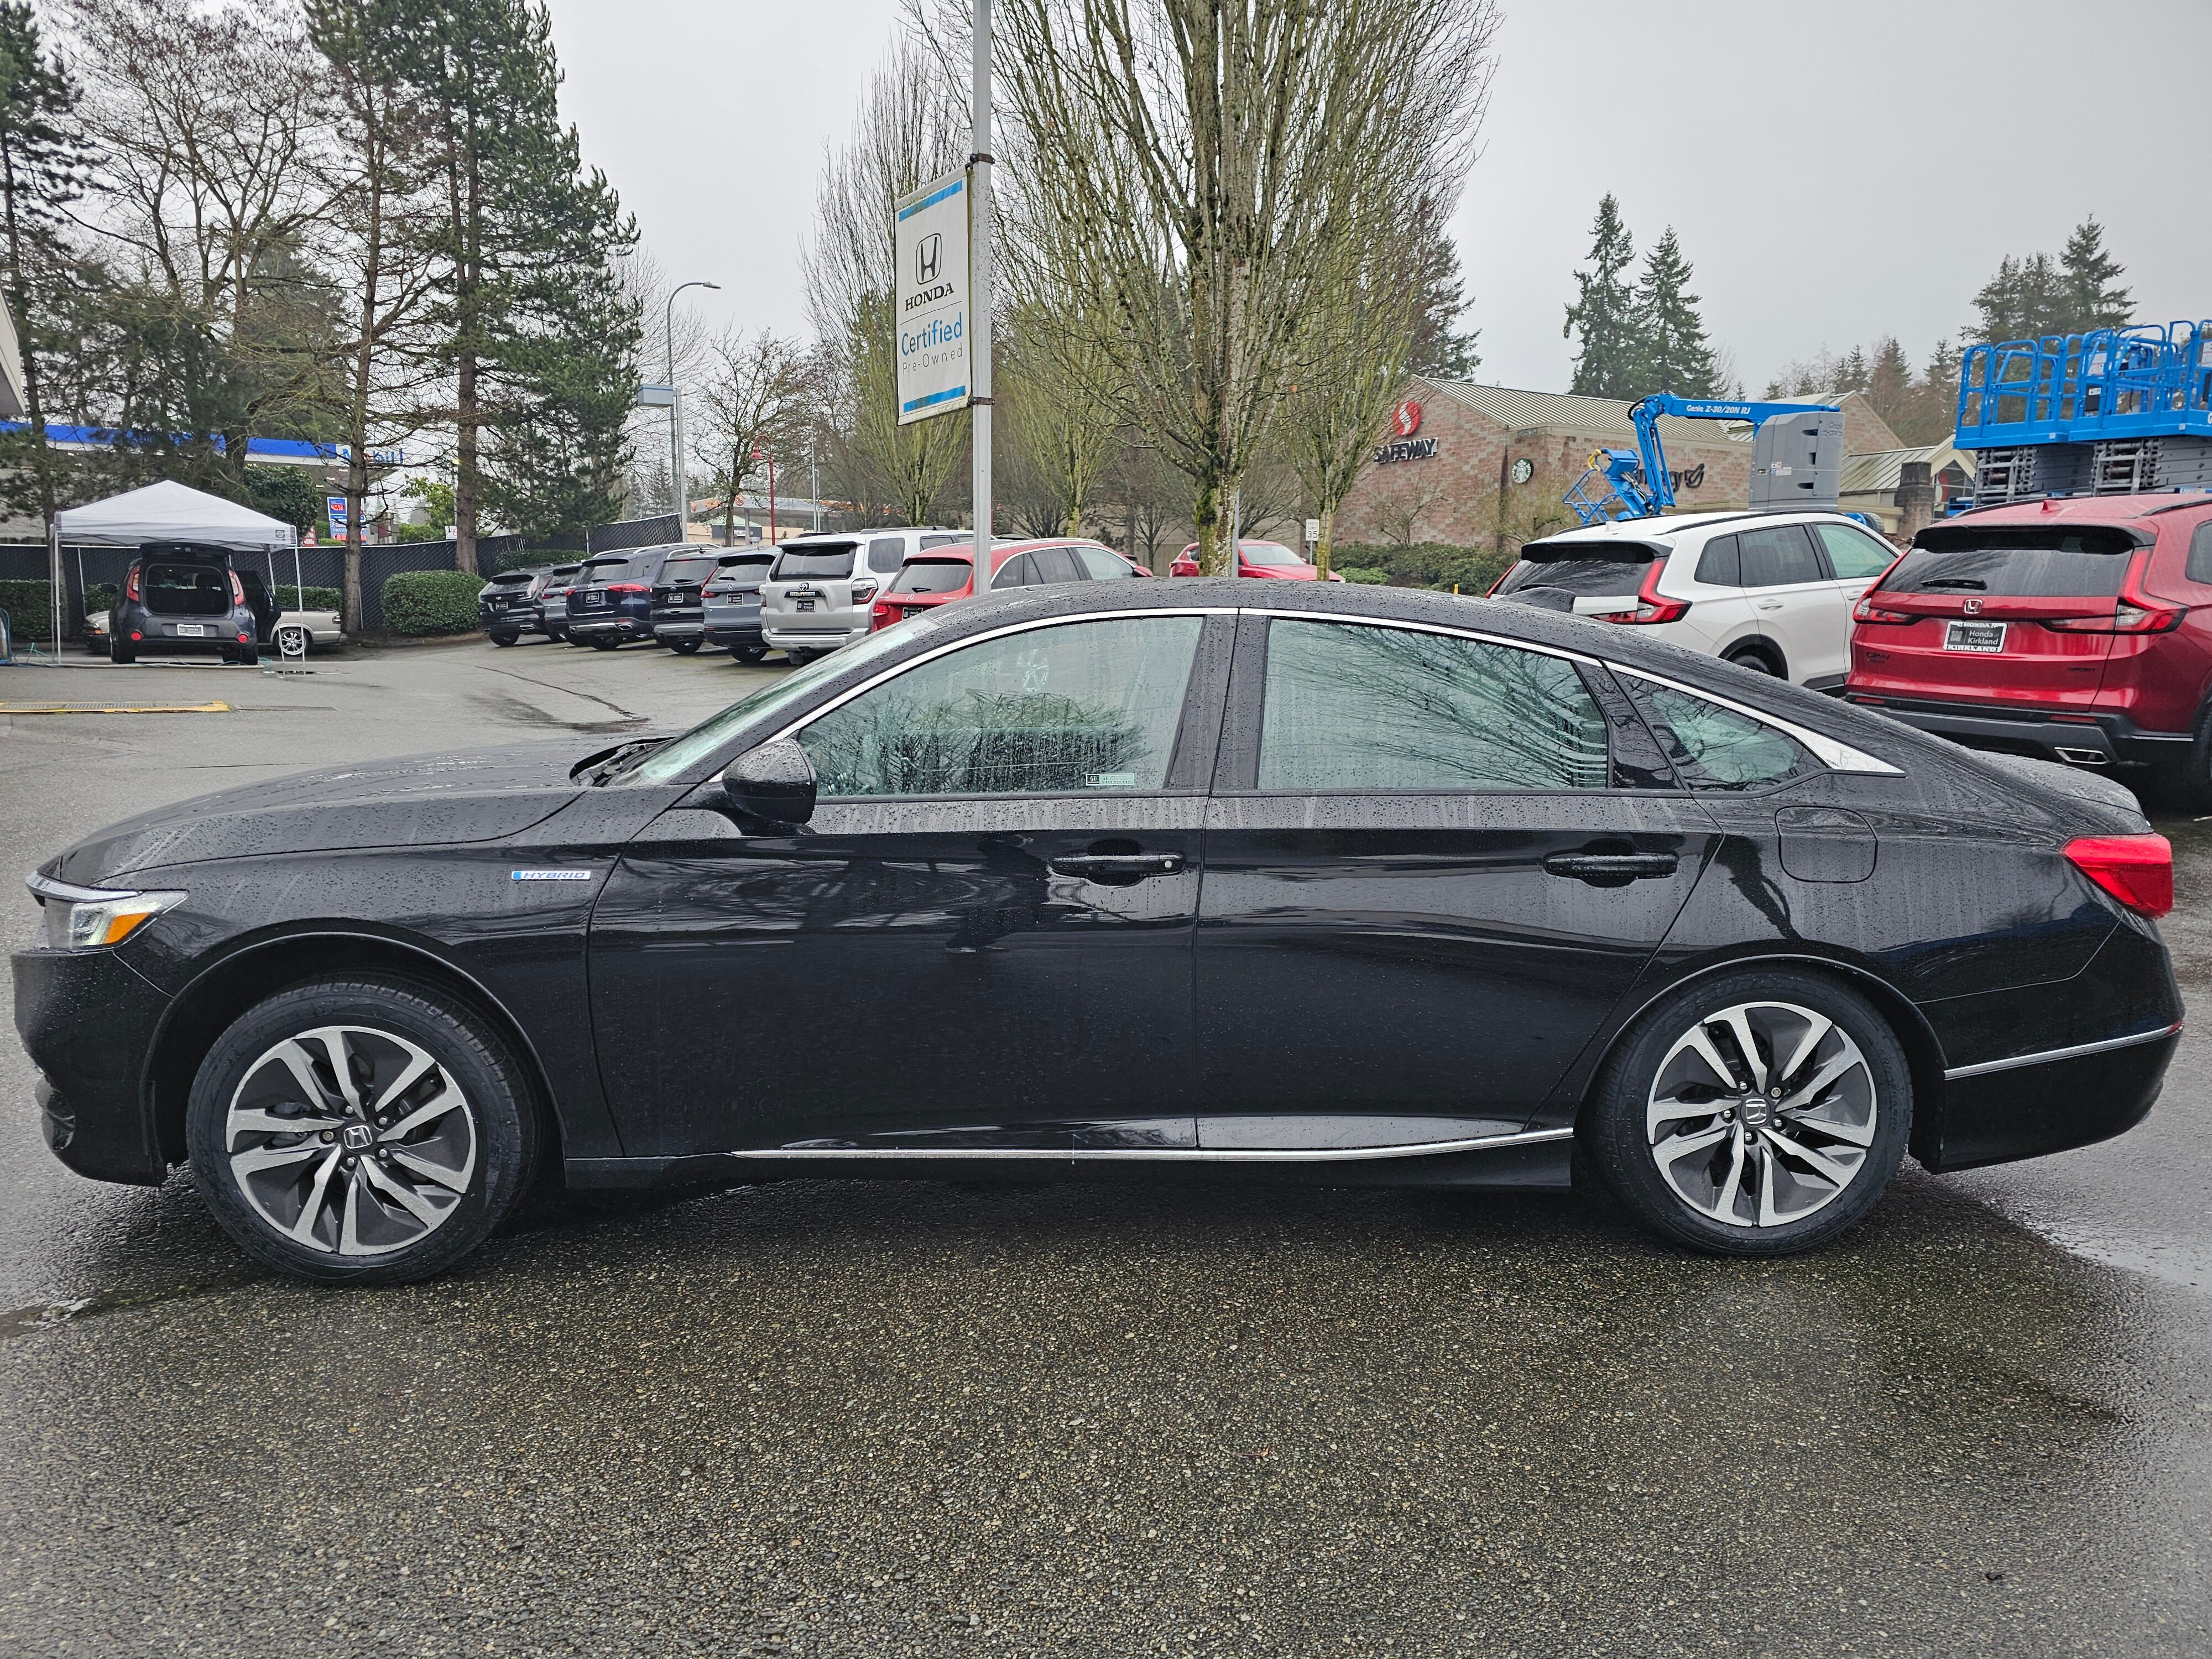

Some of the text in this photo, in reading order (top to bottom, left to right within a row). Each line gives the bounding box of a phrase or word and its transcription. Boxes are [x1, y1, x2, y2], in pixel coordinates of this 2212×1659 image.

[905, 283, 954, 311] HONDA
[902, 312, 963, 356] Certified
[902, 342, 963, 375] Pre-Owned
[1705, 405, 1740, 414] Z-30/20N
[1374, 437, 1438, 463] SAFEWAY
